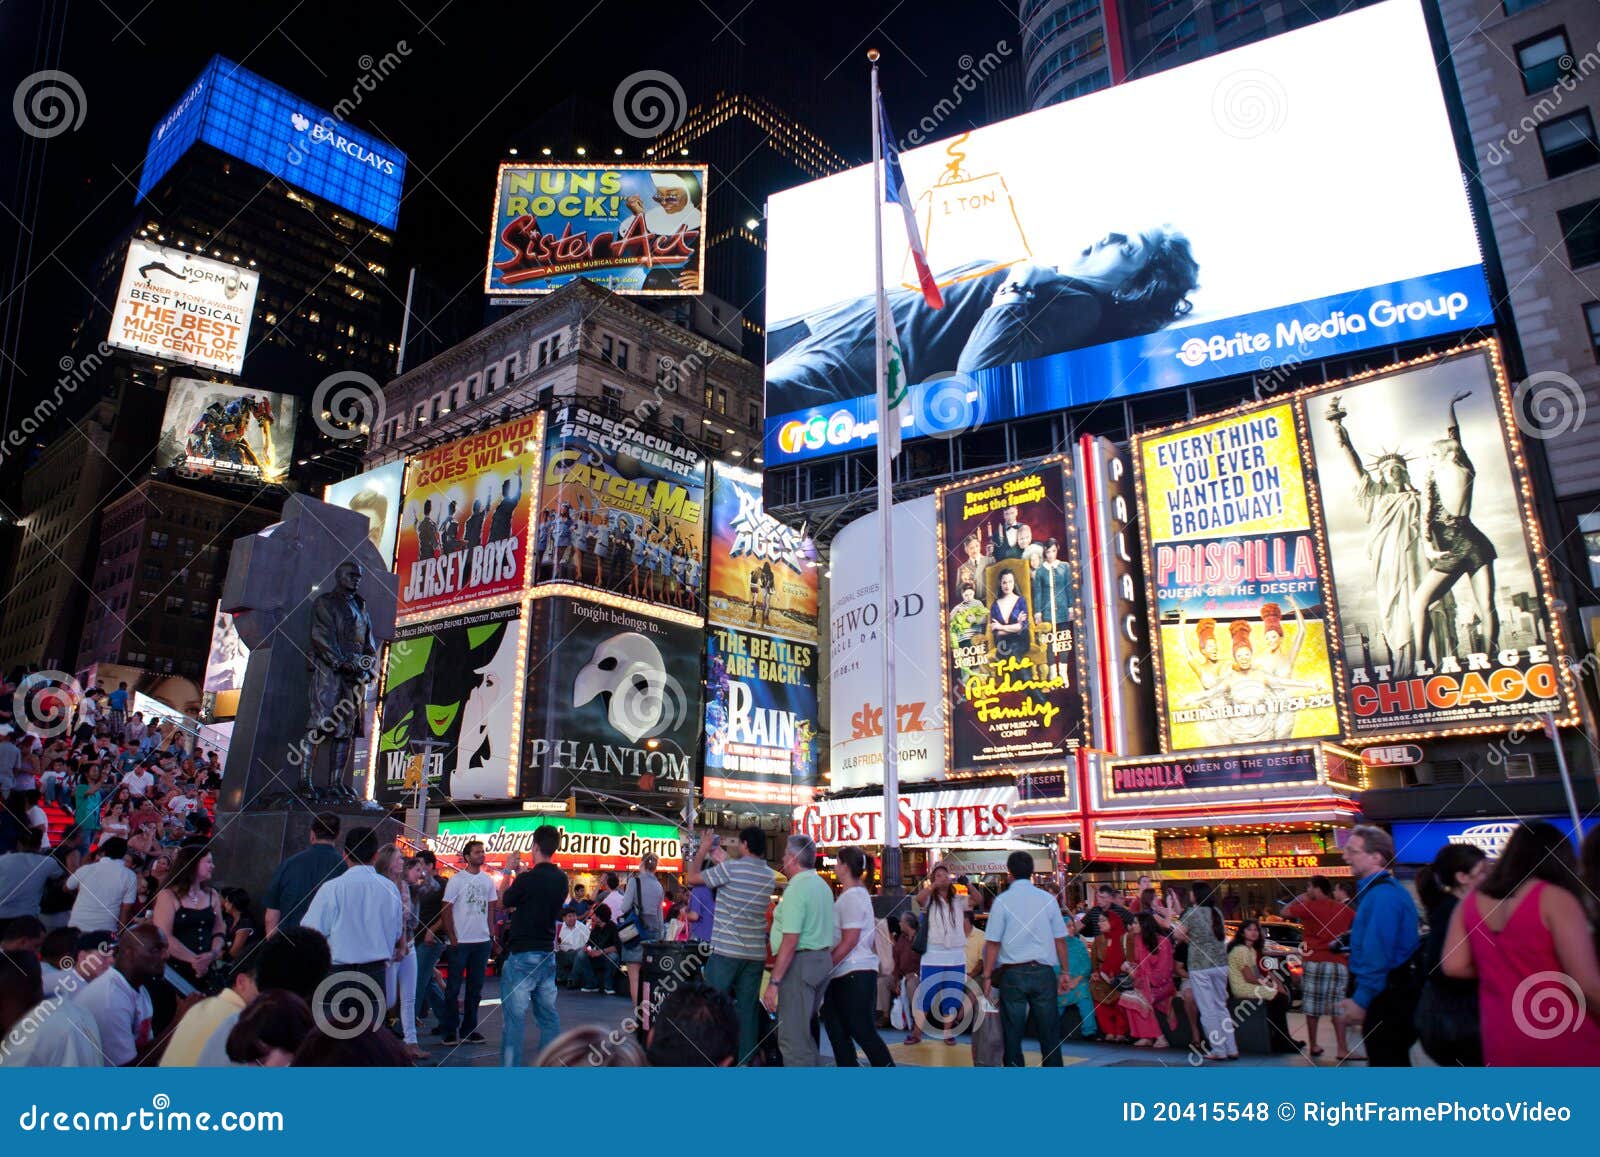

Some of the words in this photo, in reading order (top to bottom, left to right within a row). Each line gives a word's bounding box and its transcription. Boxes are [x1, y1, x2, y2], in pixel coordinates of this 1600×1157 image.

[312, 123, 394, 175] BARCLAYS
[943, 200, 952, 215] 1
[958, 190, 996, 213] TON
[494, 213, 614, 272] Sister
[609, 212, 700, 268] Act
[545, 265, 553, 274] A
[554, 261, 581, 273] DIVINE
[582, 258, 613, 270] MUSICAL
[614, 256, 639, 265] COMEDY
[133, 281, 173, 295] WINNER
[130, 289, 170, 306] BEST
[175, 300, 243, 325] MUSICAL
[122, 328, 158, 345] THIS
[124, 315, 207, 346] MUSICAL
[212, 337, 238, 352] OF
[181, 312, 240, 340] BEST
[1208, 332, 1272, 361] Brite
[1275, 311, 1367, 348] Media
[1368, 291, 1468, 328] Group
[416, 445, 455, 471] THE
[459, 419, 535, 458] CROWD
[576, 408, 698, 465] SPECTACULAR
[1157, 416, 1279, 466] EVERYTHING
[416, 457, 470, 488] GOES
[1173, 458, 1209, 486] YOU
[1216, 445, 1265, 477] EVER
[545, 450, 649, 507] CATCH
[651, 479, 702, 525] ME
[963, 503, 989, 521] joins
[989, 497, 1007, 511] the
[1008, 486, 1046, 506] family!
[965, 486, 1003, 505] Brooke
[1003, 474, 1042, 495] Shields
[1167, 474, 1245, 512] WANTED
[1252, 466, 1281, 493] ON
[1171, 491, 1283, 536] BROADWAY!
[403, 548, 469, 603] JERSEY
[469, 535, 517, 588] BOYS
[1109, 456, 1142, 686] PALACE
[1157, 535, 1318, 588] PRISCILLA
[856, 583, 880, 598] SERIES
[1157, 586, 1202, 599] QUEEN
[1206, 585, 1226, 597] OF
[1229, 584, 1256, 596] THE
[1261, 581, 1317, 594] DESERT
[463, 613, 490, 624] DOROTHY
[490, 609, 516, 620] DROPPED
[571, 601, 609, 622] Tonight
[611, 608, 648, 633] belongs
[831, 593, 925, 645] CHWOD
[750, 637, 812, 667] BEATLES
[952, 644, 987, 659] BROOKE
[1041, 629, 1072, 644] ROGER
[725, 654, 755, 679] ARE
[953, 655, 989, 669] SHIELDS
[989, 655, 1034, 676] The
[1352, 665, 1392, 684] AT
[1416, 644, 1550, 677] LARGE
[964, 673, 1064, 700] Addams
[1350, 662, 1558, 717] CHICAGO
[726, 679, 797, 749] RAIN
[973, 695, 1060, 728] Family
[988, 724, 996, 732] A
[996, 722, 1010, 731] NEW
[1010, 719, 1040, 730] MUSICAL
[1000, 729, 1028, 739] COMEDY
[386, 750, 444, 781] WIED
[528, 738, 691, 783] PHANTOM
[858, 752, 883, 767] FRIDA
[1368, 747, 1414, 764] FUEL
[1029, 774, 1062, 785] DESERT
[1114, 763, 1185, 791] PRISCILLA
[1184, 762, 1221, 774] QUEEN
[1224, 761, 1238, 771] OF
[1241, 758, 1263, 768] THE
[1266, 755, 1311, 767] DESERT
[802, 805, 882, 843] GUEST
[898, 797, 1008, 840] SUITES
[485, 826, 535, 854] sbarro
[558, 827, 610, 855] barro
[619, 832, 677, 858] sbarro
[1217, 857, 1236, 869] THE
[1261, 856, 1295, 869] OFFICE
[1297, 855, 1318, 868] FOR
